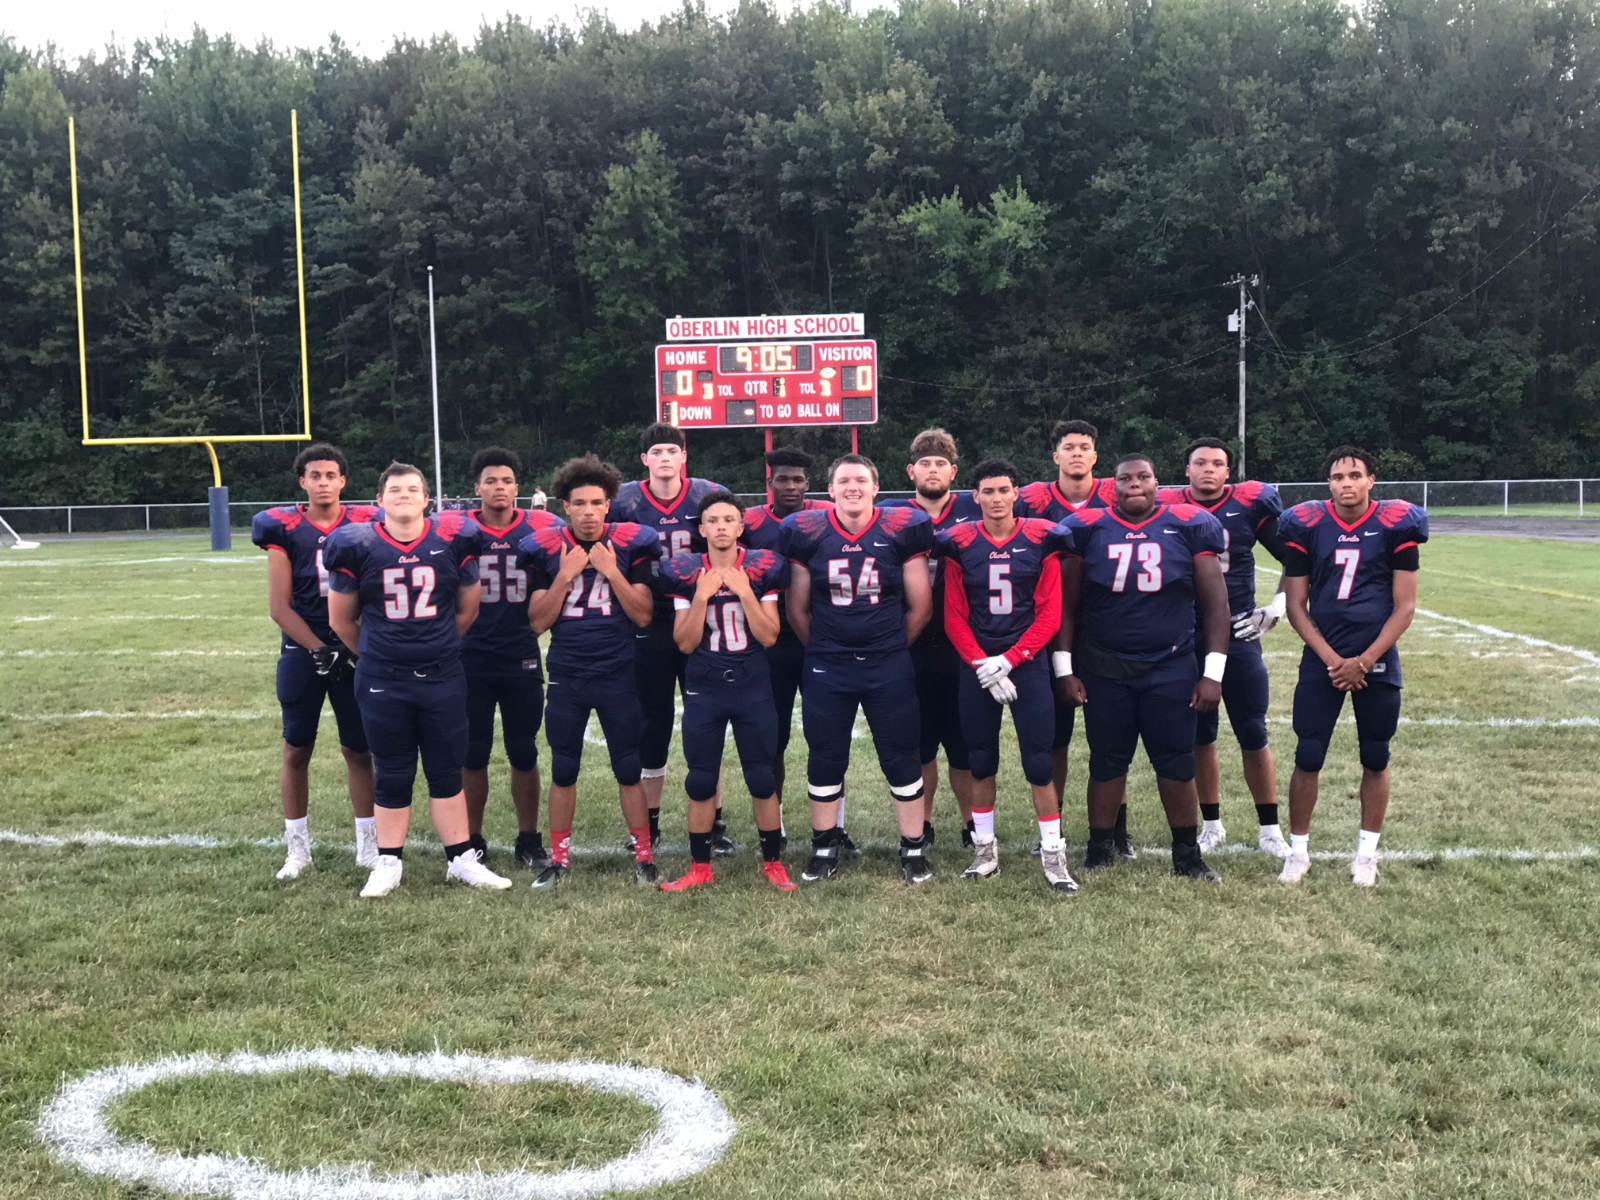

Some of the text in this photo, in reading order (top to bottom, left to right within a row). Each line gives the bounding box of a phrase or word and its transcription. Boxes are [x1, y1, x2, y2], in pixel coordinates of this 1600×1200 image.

[669, 316, 860, 338] OBERLIN HIGH SCHOOL
[665, 350, 707, 366] HOME
[818, 346, 873, 361] VISITOR
[676, 369, 693, 396] 0
[717, 384, 734, 397] TOL
[744, 379, 768, 396] QTR
[799, 382, 816, 395] TOL
[856, 365, 873, 391] 0
[680, 405, 712, 421] DOWN
[760, 403, 792, 419] TO GO
[797, 402, 840, 418] BALL ON
[478, 554, 528, 604] 55
[1107, 542, 1163, 593] 73
[1334, 548, 1361, 600] 7
[382, 565, 438, 621] 52
[828, 556, 882, 607] 54
[988, 563, 1014, 616] 5
[562, 572, 613, 618] 24
[706, 601, 748, 652] 10
